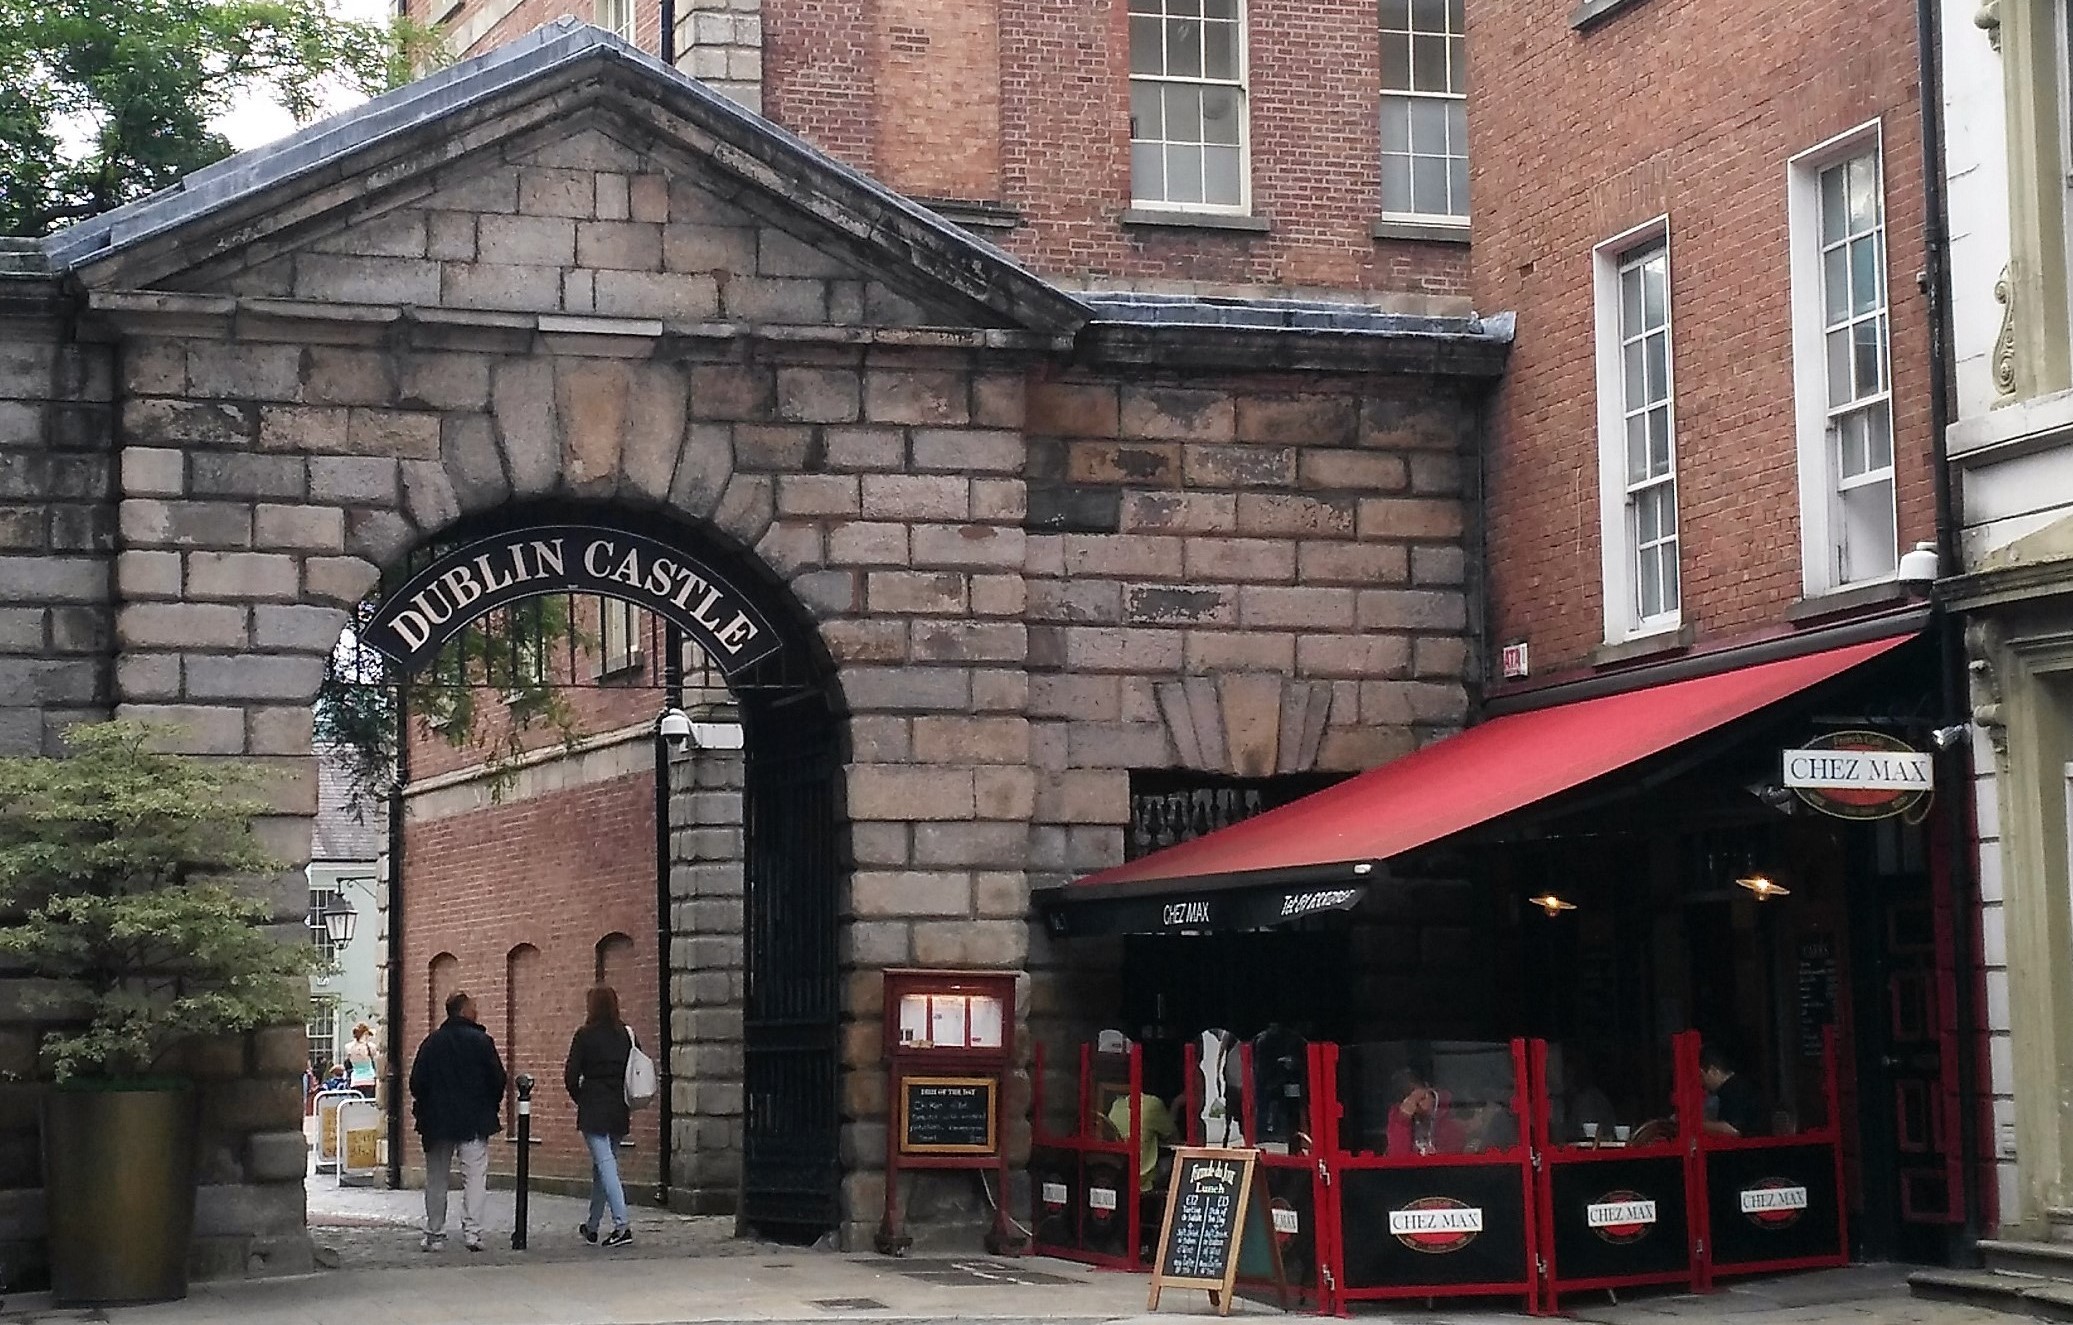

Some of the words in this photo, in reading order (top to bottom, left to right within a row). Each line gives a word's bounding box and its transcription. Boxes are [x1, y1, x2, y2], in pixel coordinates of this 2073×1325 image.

[388, 539, 565, 653] DUBLIN
[584, 540, 760, 654] CASTLE
[1791, 758, 1860, 780] CHEZ
[1868, 760, 1927, 782] MAX
[1163, 903, 1185, 925] CHEZ
[1186, 902, 1210, 922] MAX
[1195, 1182, 1225, 1194] Lunch
[1744, 1193, 1775, 1208] CHEZ
[1778, 1191, 1805, 1206] MAX
[1393, 1214, 1437, 1230] CHEZ
[1442, 1213, 1479, 1227] MAX
[1590, 1207, 1623, 1223] CHEZ
[1628, 1205, 1653, 1220] MAX
